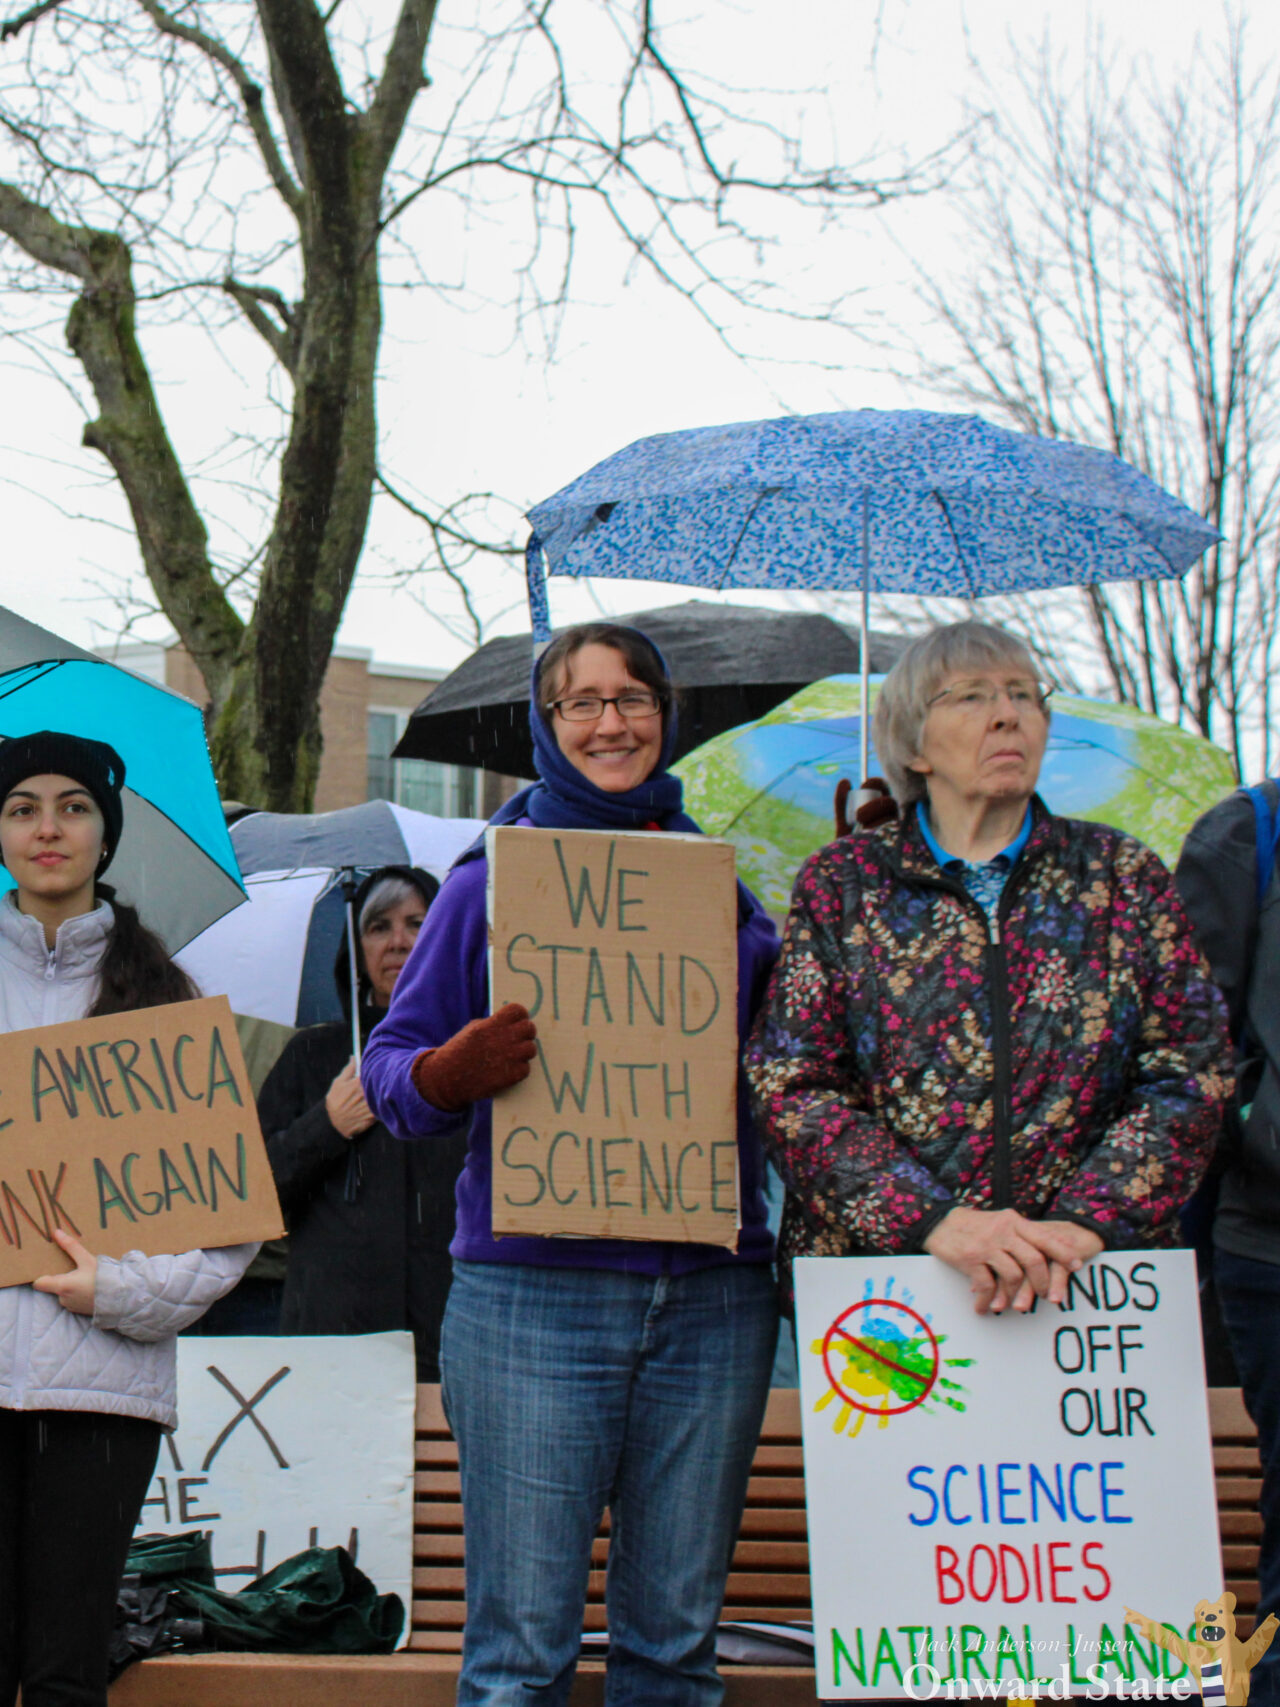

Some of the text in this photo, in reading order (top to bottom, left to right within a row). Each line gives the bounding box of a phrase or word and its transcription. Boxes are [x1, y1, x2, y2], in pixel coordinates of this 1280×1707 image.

[553, 838, 650, 931] WE
[503, 933, 720, 1036] STAND
[31, 1026, 245, 1123] AMERICA
[535, 1038, 692, 1120] WITH
[93, 1132, 249, 1229] AGAIN
[501, 1126, 738, 1216] SCIENCE
[1054, 1325, 1145, 1374] OFF
[1060, 1387, 1156, 1437] OUR
[135, 1477, 222, 1525] HE
[907, 1461, 1134, 1527] SCIENCE
[935, 1542, 1112, 1605] BODIES
[831, 1624, 1057, 1687] NATURAL
